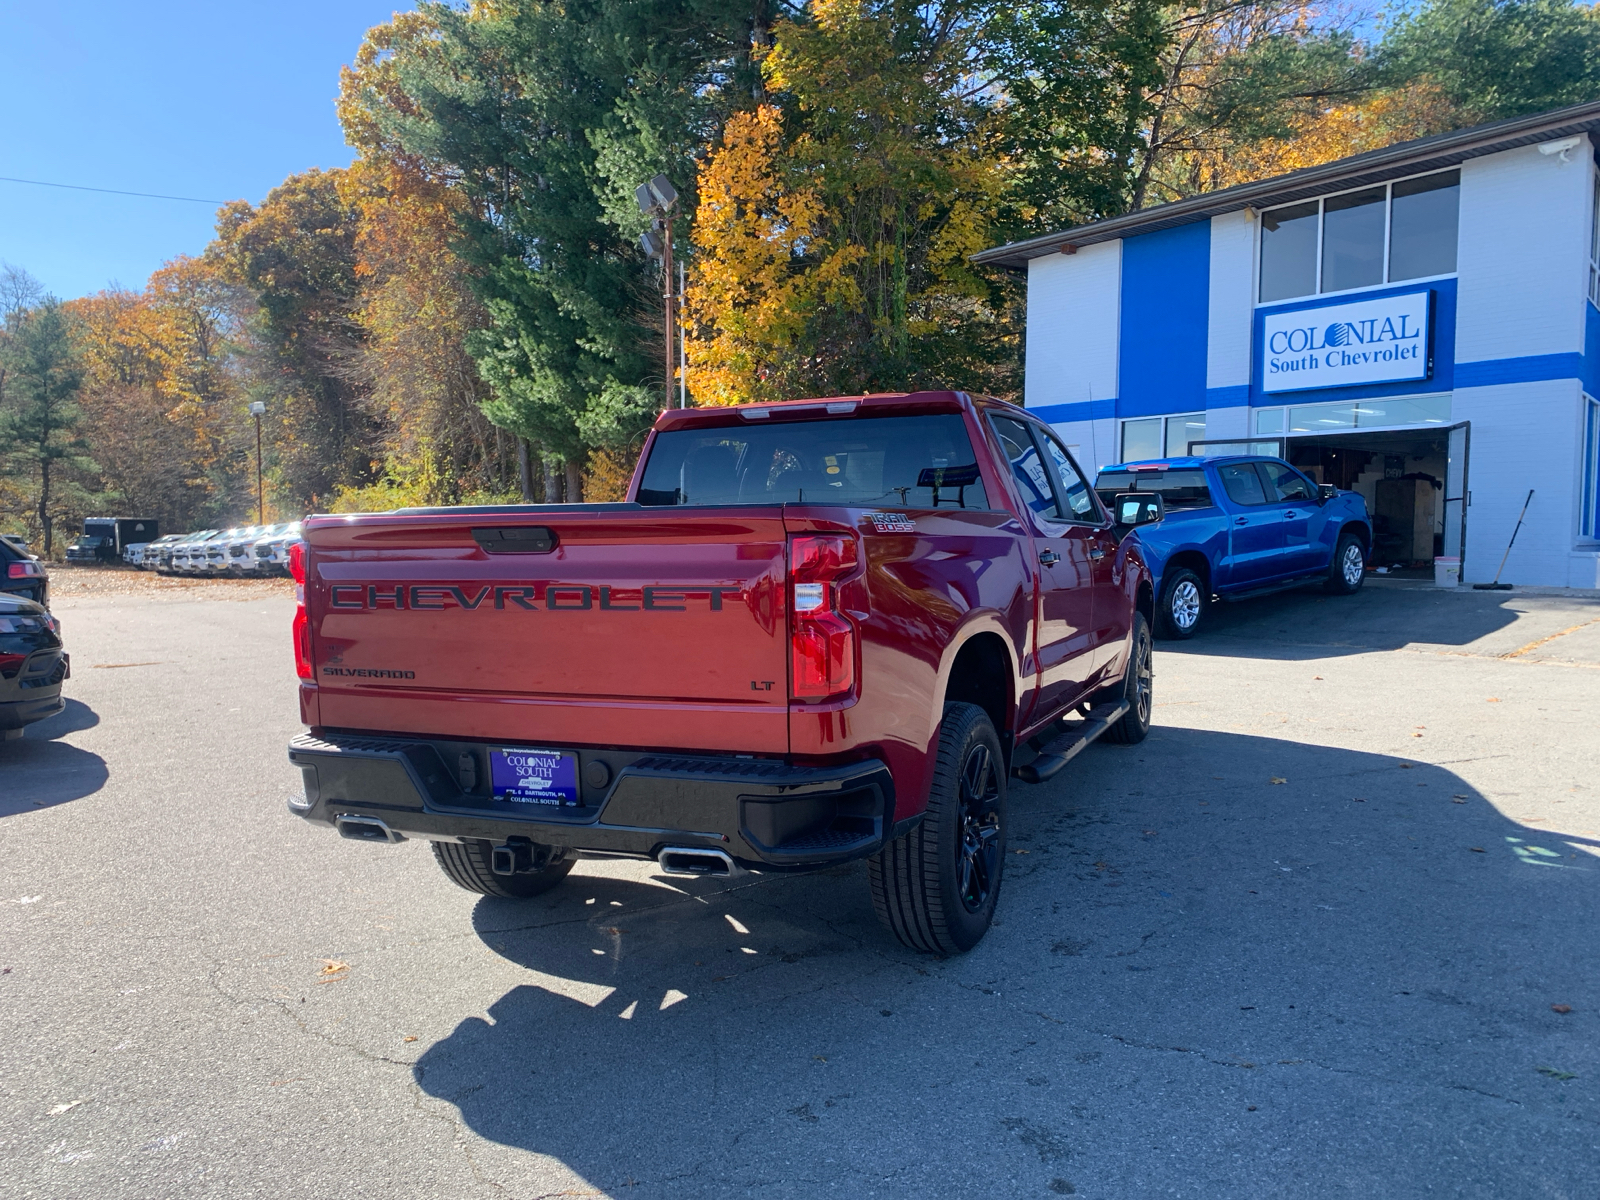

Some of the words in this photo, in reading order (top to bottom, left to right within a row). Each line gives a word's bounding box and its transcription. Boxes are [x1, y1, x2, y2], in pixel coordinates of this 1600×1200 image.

[1269, 314, 1420, 355] COLONIAL
[1269, 353, 1319, 374] South
[1325, 343, 1419, 368] Chevrolet
[861, 511, 917, 525] TRAIL
[874, 523, 915, 533] BOSS
[331, 584, 741, 611] CHEVROLET
[322, 667, 416, 680] SILVERADO
[750, 680, 775, 691] LT
[507, 756, 559, 768] COLONIAL
[516, 767, 552, 777] SOUTH
